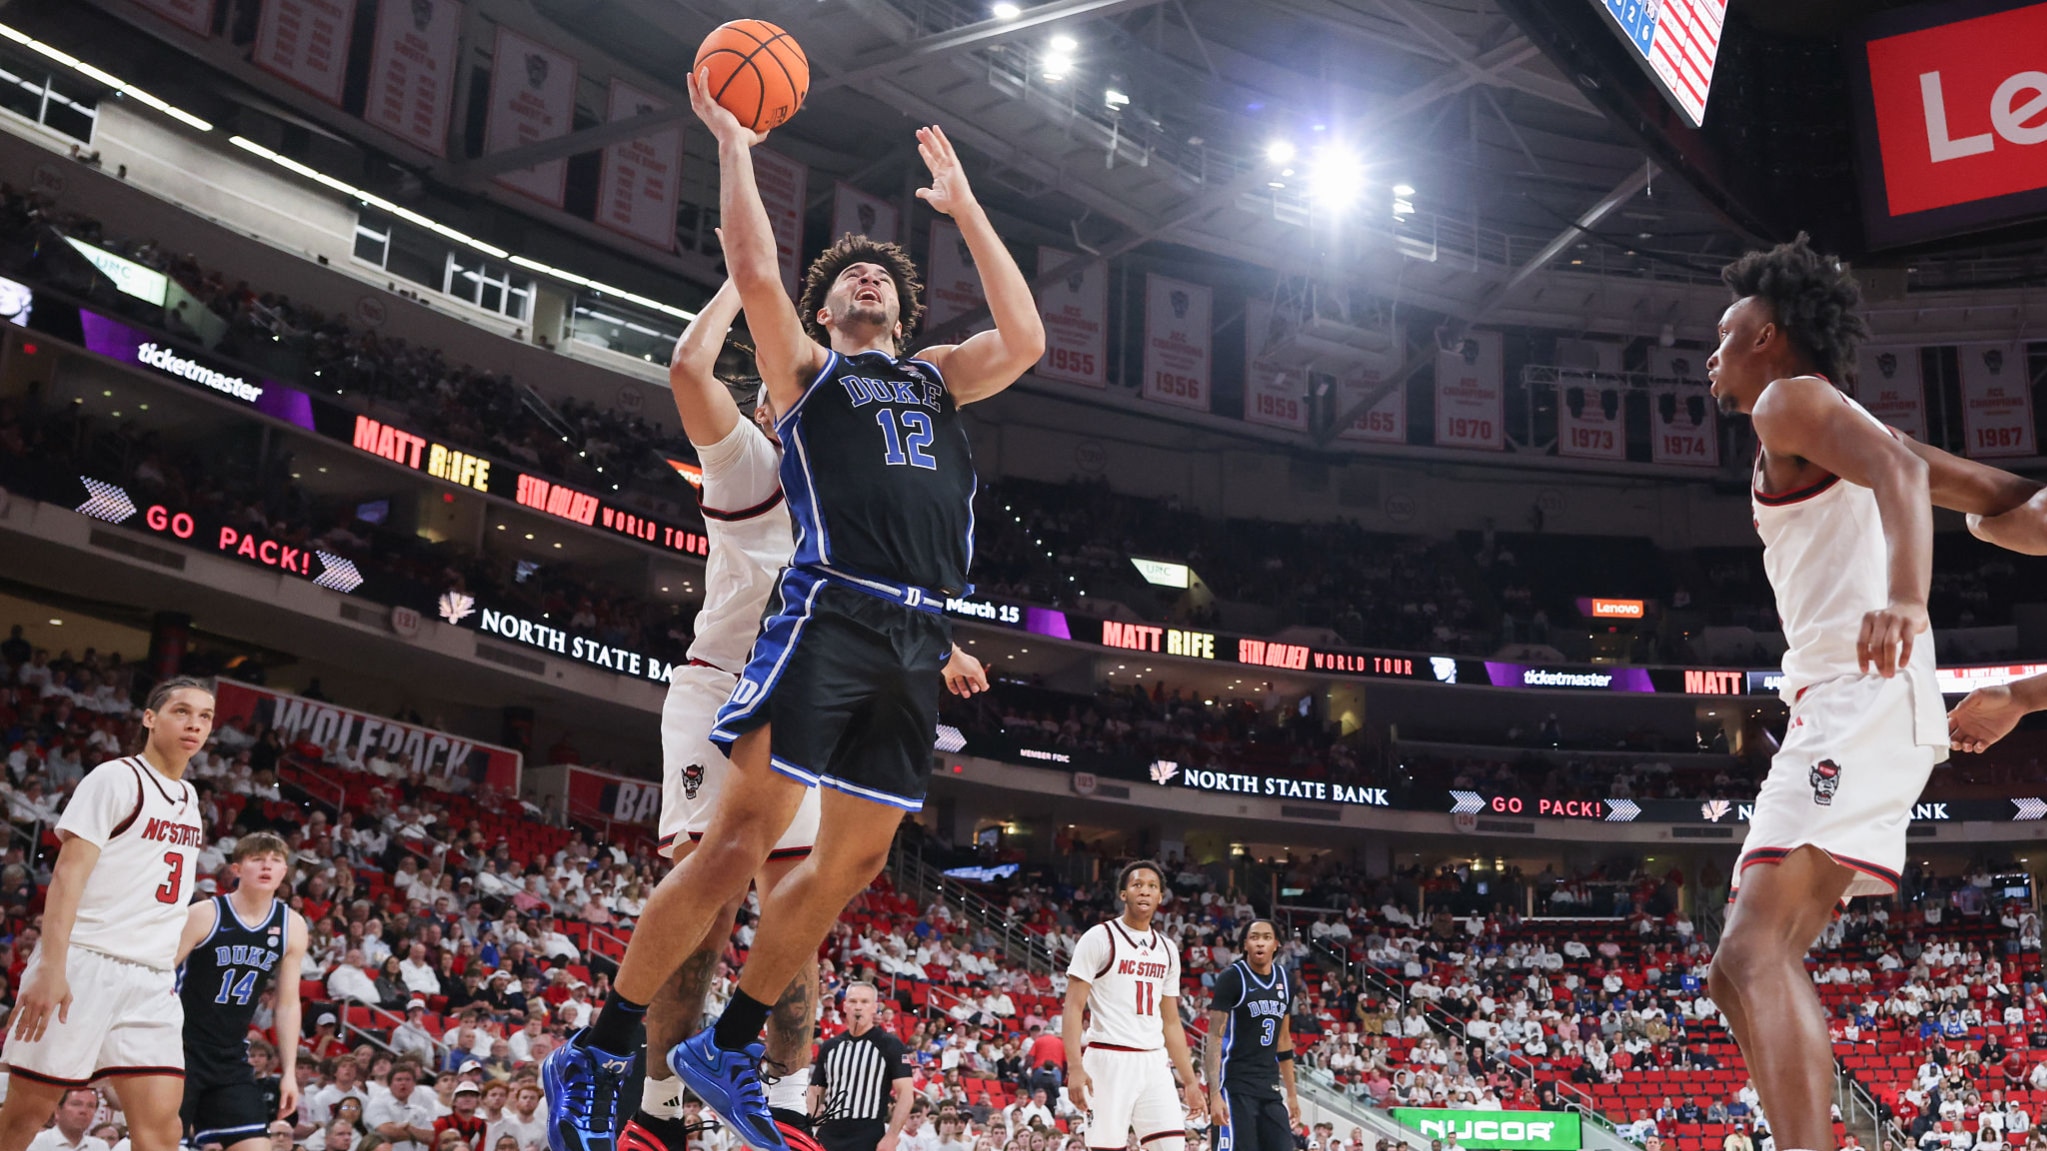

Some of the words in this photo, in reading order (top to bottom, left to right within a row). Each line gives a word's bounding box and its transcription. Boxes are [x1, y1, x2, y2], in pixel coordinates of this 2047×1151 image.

[137, 342, 263, 403] ticketmaster
[1047, 346, 1095, 375] 1955
[838, 375, 942, 413] DUKE
[1155, 371, 1199, 399] 1956
[1256, 393, 1298, 420] 1959
[876, 408, 936, 471] 12
[1449, 417, 1492, 439] 1970
[1571, 427, 1613, 450] 1973
[1977, 427, 2022, 448] 1987
[354, 416, 425, 470] MATT
[1664, 434, 1706, 456] 1974
[146, 504, 194, 539] GO
[219, 526, 310, 575] PACK!
[602, 507, 656, 542] WORLD
[664, 527, 708, 556] TOUR
[903, 586, 922, 607] D
[945, 597, 996, 620] March
[999, 604, 1021, 624] 15
[1596, 602, 1640, 614] Lenovo
[480, 607, 566, 654] NORTH
[571, 636, 641, 676] STATE
[1102, 620, 1163, 653] MATT
[1167, 629, 1215, 660] RIFE
[1238, 639, 1265, 665] STAY
[1314, 652, 1365, 672] WORLD
[1374, 658, 1413, 676] TOUR
[1523, 669, 1612, 689] ticketmaster
[1685, 671, 1743, 696] MATT
[271, 697, 474, 780] WOLFPACK
[1184, 768, 1258, 795] NORTH
[1264, 778, 1325, 800] STATE
[1332, 784, 1390, 807] BANK
[1491, 796, 1523, 814] GO
[1538, 799, 1601, 818] PACK!
[142, 817, 170, 842] NC
[169, 822, 202, 849] STATE
[155, 851, 183, 905] 3
[215, 945, 279, 972] DUKE
[1118, 959, 1135, 975] NC
[1137, 962, 1167, 980] STATE
[214, 968, 257, 1005] 14
[1135, 980, 1154, 1016] 11
[1247, 1000, 1287, 1020] DUKE
[1260, 1018, 1275, 1047] 3
[1419, 1119, 1552, 1143] NUCOR
